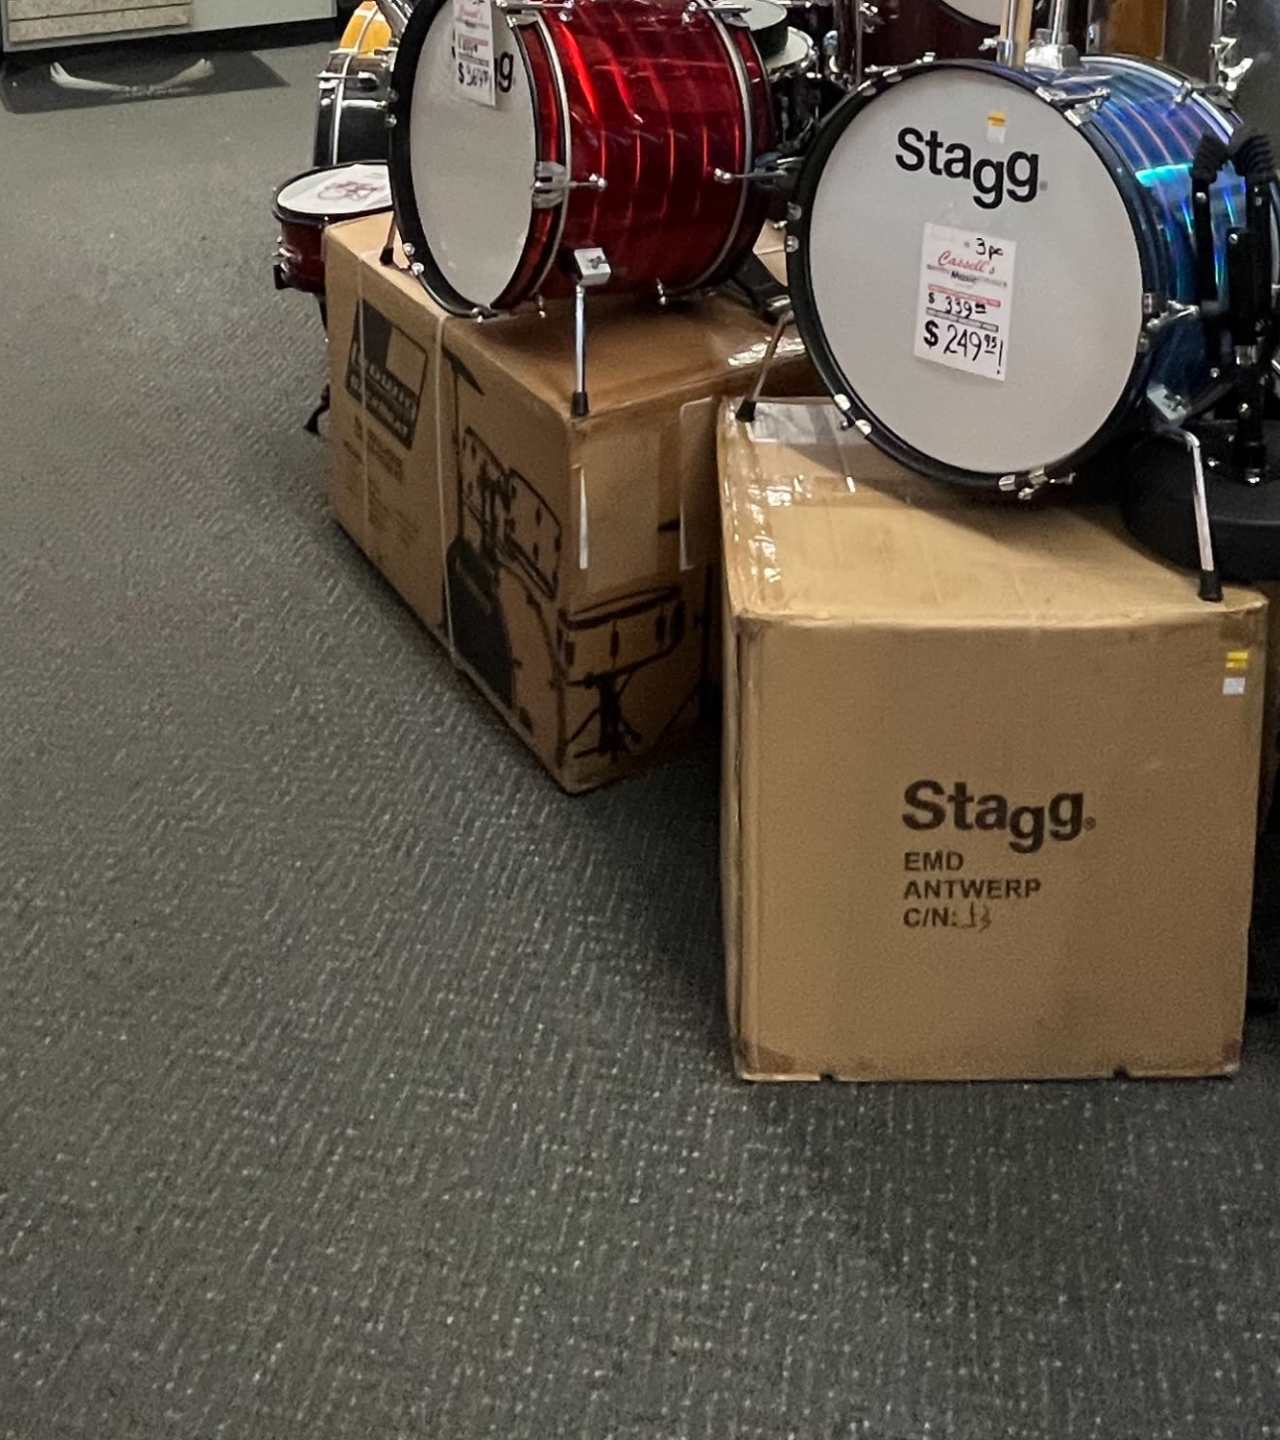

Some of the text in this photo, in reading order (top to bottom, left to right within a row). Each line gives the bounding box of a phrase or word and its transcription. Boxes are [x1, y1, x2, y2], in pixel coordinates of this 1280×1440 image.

[895, 127, 1041, 209] Stagg
[901, 779, 1084, 855] Stagg
[903, 850, 965, 872] EMD
[904, 878, 1041, 899] ANTWERP
